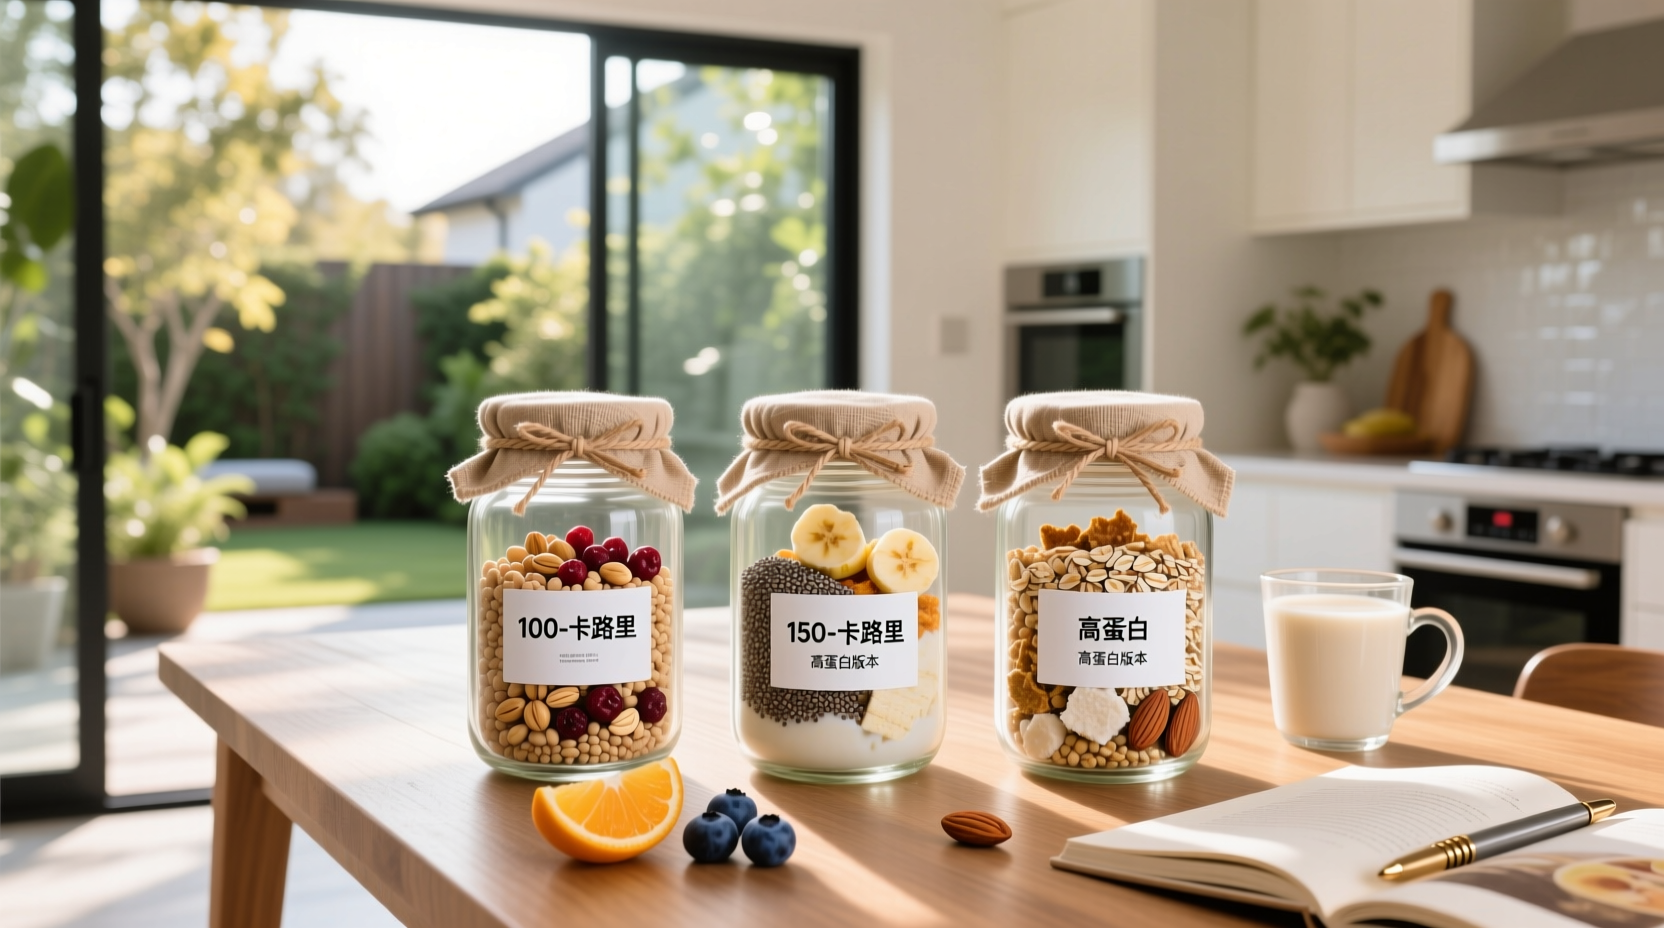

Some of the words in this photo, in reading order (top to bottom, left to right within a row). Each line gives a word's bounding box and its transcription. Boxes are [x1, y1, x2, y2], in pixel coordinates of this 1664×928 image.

[518, 614, 637, 641] 100-卡路里
[787, 619, 905, 645] 150-卡路里
[1078, 616, 1148, 642] 高蛋白
